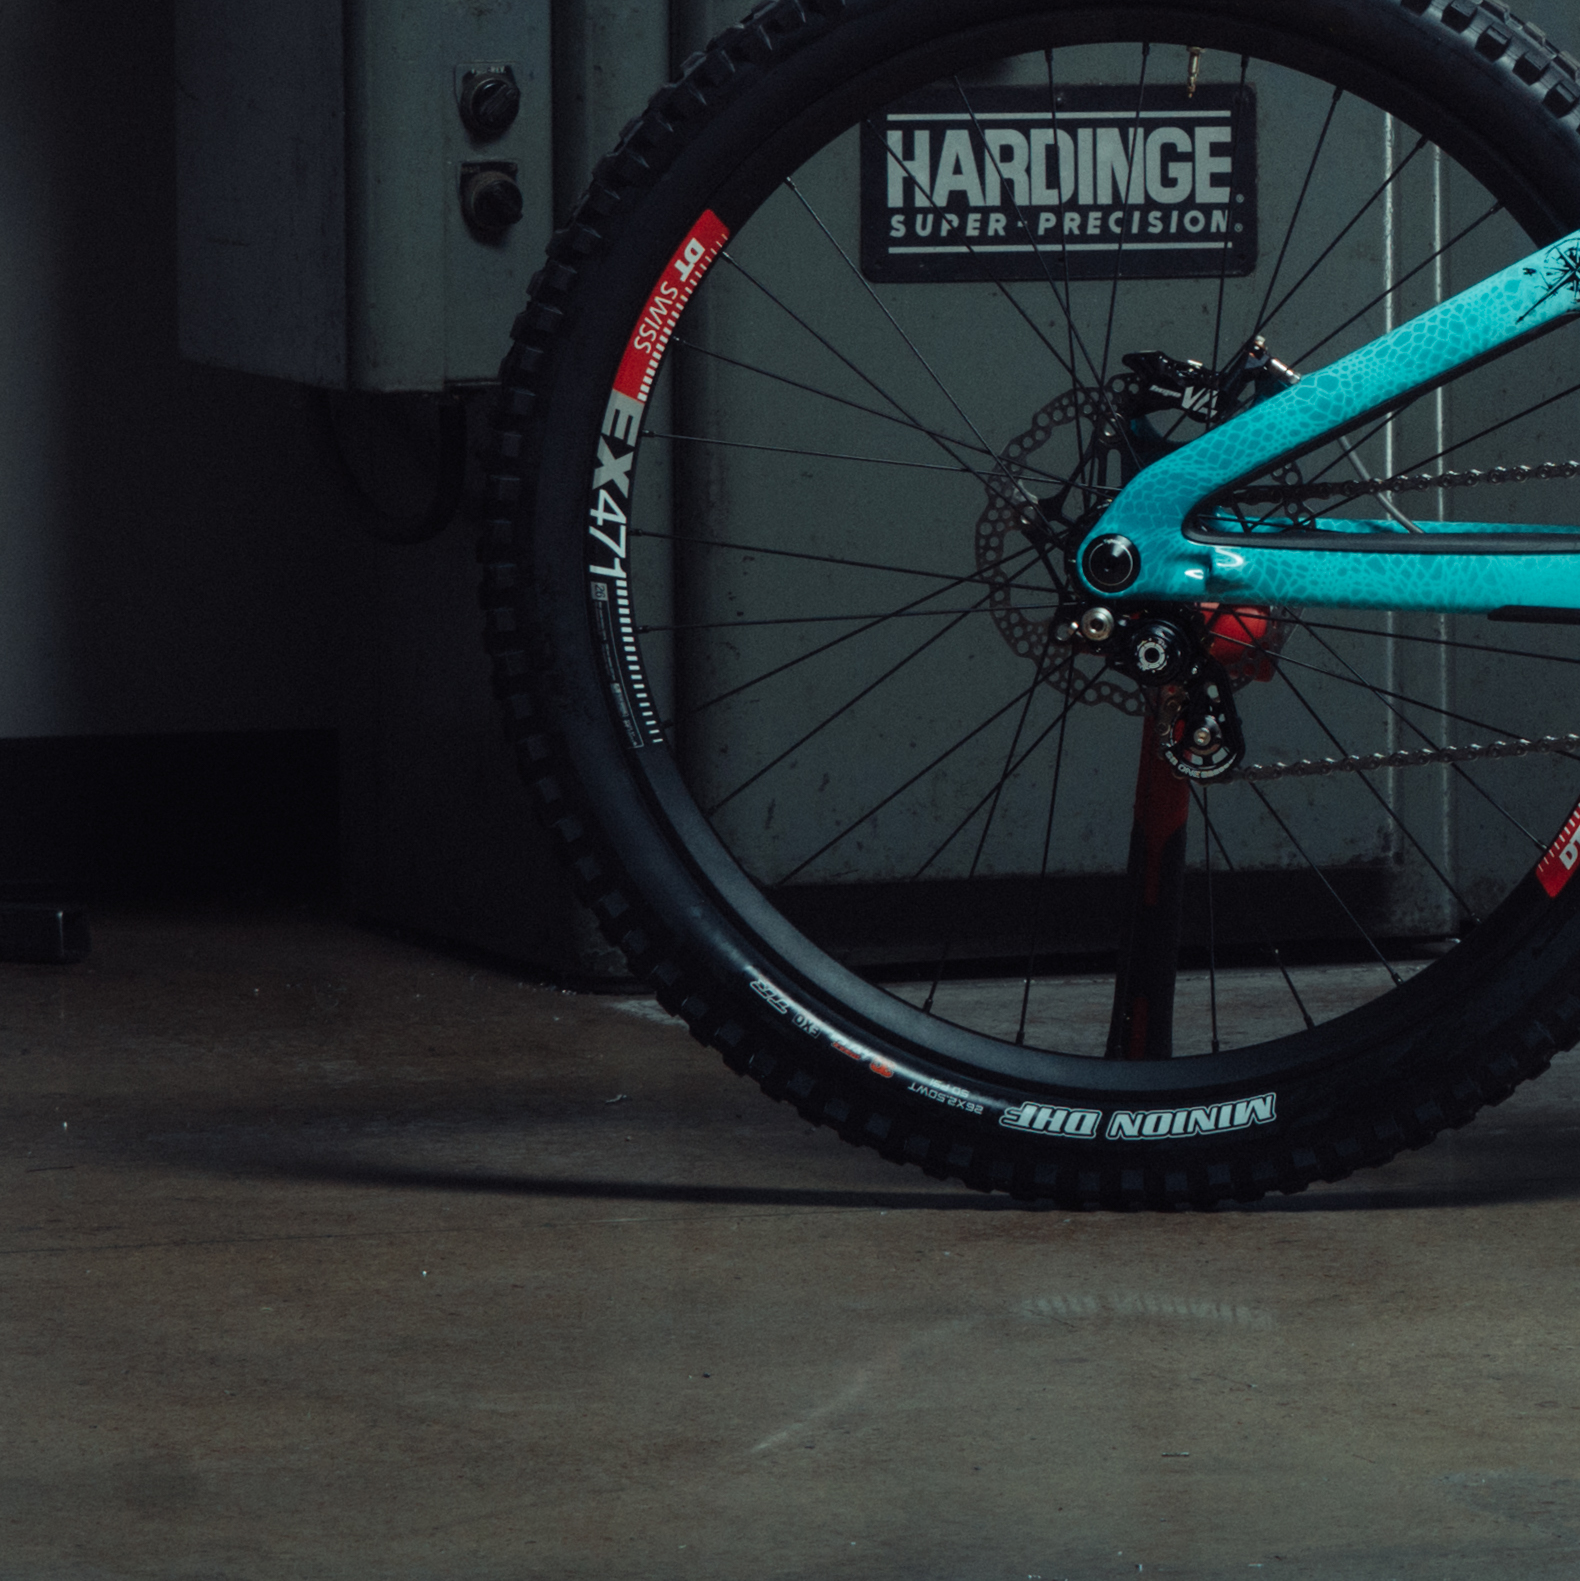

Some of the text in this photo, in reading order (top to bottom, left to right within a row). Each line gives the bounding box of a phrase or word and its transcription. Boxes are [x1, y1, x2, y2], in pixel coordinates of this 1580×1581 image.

[886, 126, 1233, 208] HARDINGE
[633, 237, 706, 356] DT SWISS
[588, 396, 638, 582] EX471
[593, 583, 606, 600] 26
[792, 1015, 823, 1040] EXO
[908, 1081, 984, 1115] 26X2.50WT
[1000, 1093, 1275, 1139] MINION DHF
